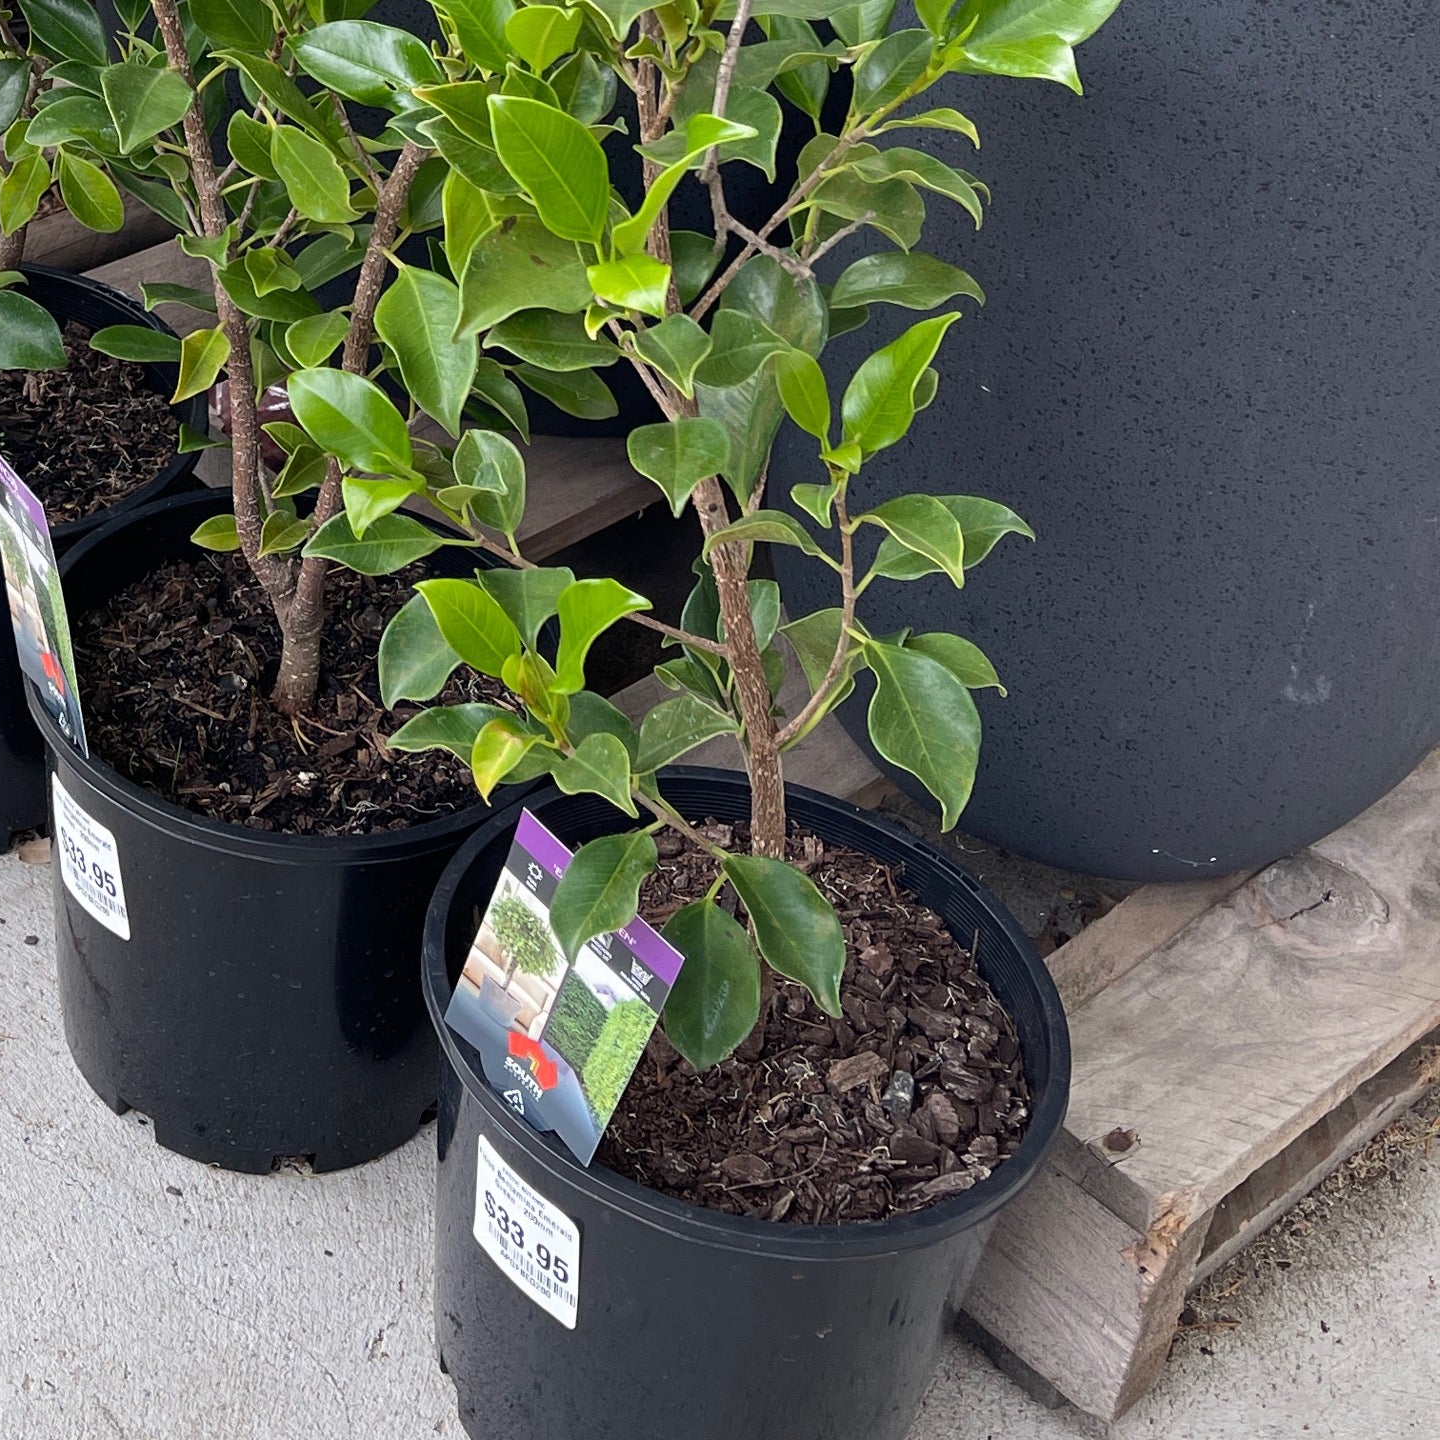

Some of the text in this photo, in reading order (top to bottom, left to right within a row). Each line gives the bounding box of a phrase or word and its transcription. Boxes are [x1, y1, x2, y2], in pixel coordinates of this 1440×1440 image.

[61, 826, 117, 897] $33.95
[484, 1189, 570, 1284] $33.95
[538, 1209, 572, 1242] Emerald
